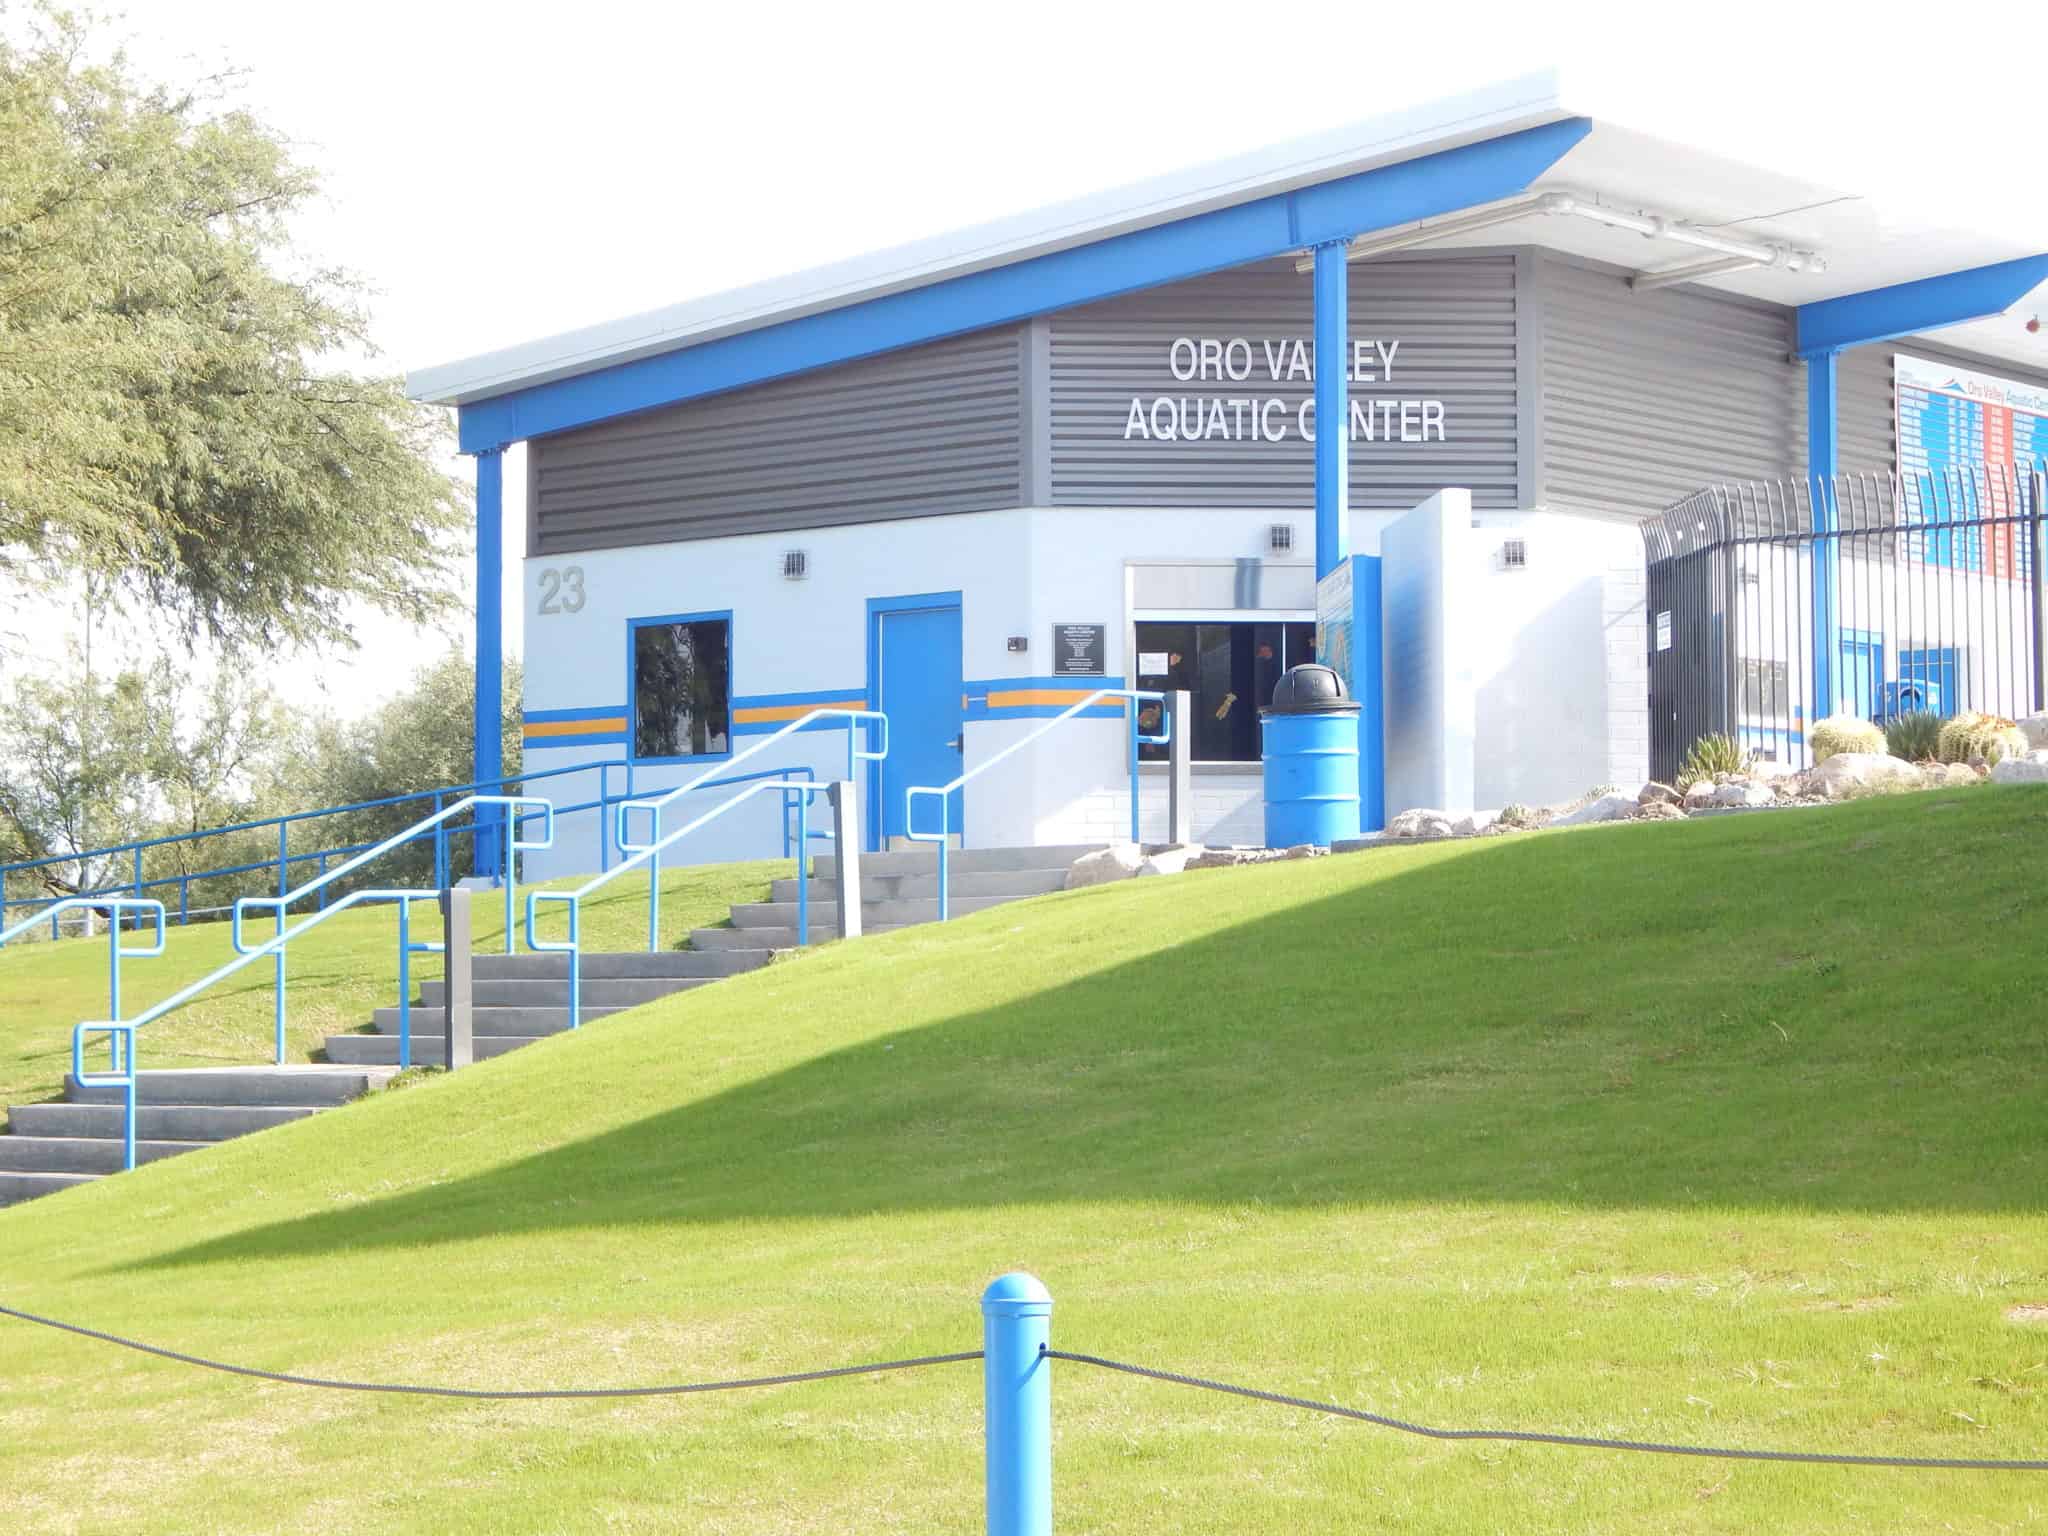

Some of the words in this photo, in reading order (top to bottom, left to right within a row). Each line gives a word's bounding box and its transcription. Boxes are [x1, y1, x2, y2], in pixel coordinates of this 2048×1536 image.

[1170, 338, 1252, 381] ORO
[1264, 340, 1399, 381] VAEY
[1124, 397, 1287, 441] AQUATIC
[1298, 399, 1446, 441] CNTER
[537, 566, 586, 615] 23
